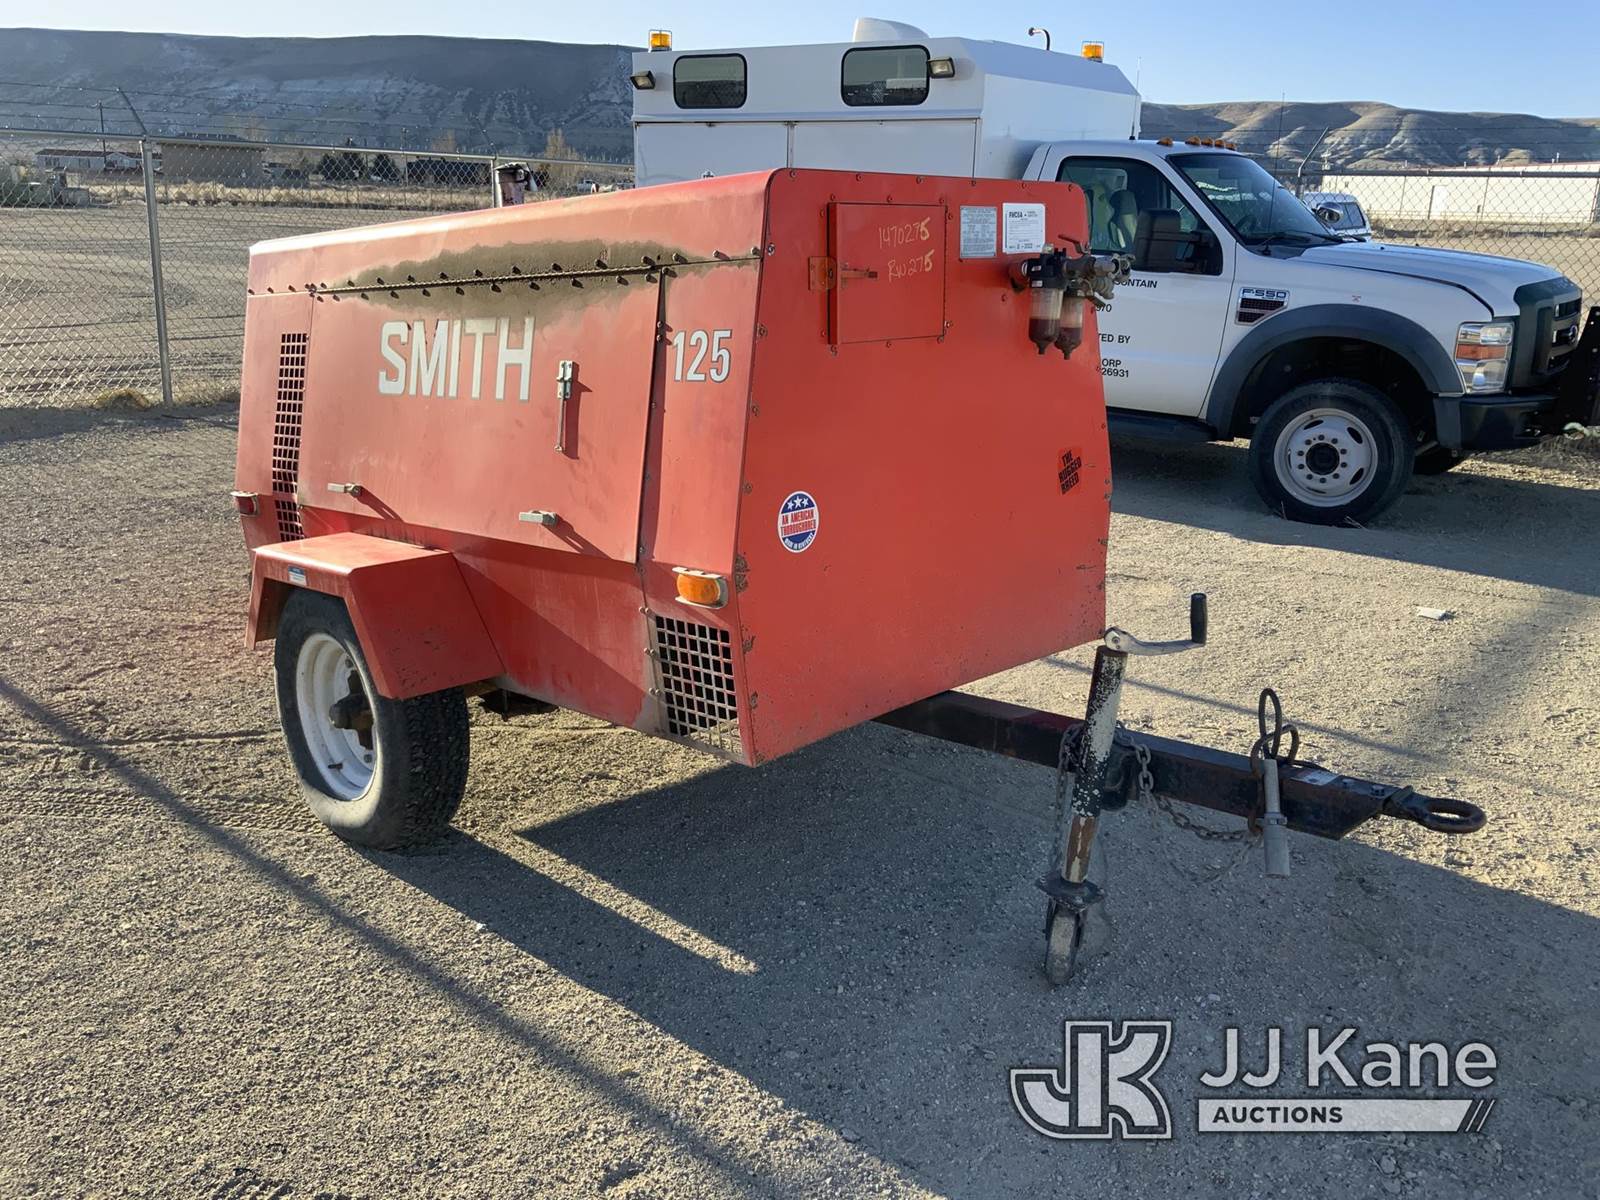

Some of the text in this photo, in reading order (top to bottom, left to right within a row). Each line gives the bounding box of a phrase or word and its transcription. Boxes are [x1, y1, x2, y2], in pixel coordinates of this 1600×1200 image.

[1118, 335, 1131, 344] BY
[378, 316, 536, 401] SMITH
[672, 329, 732, 383] 125
[1062, 450, 1073, 467] THE
[791, 509, 814, 523] AMERICAN
